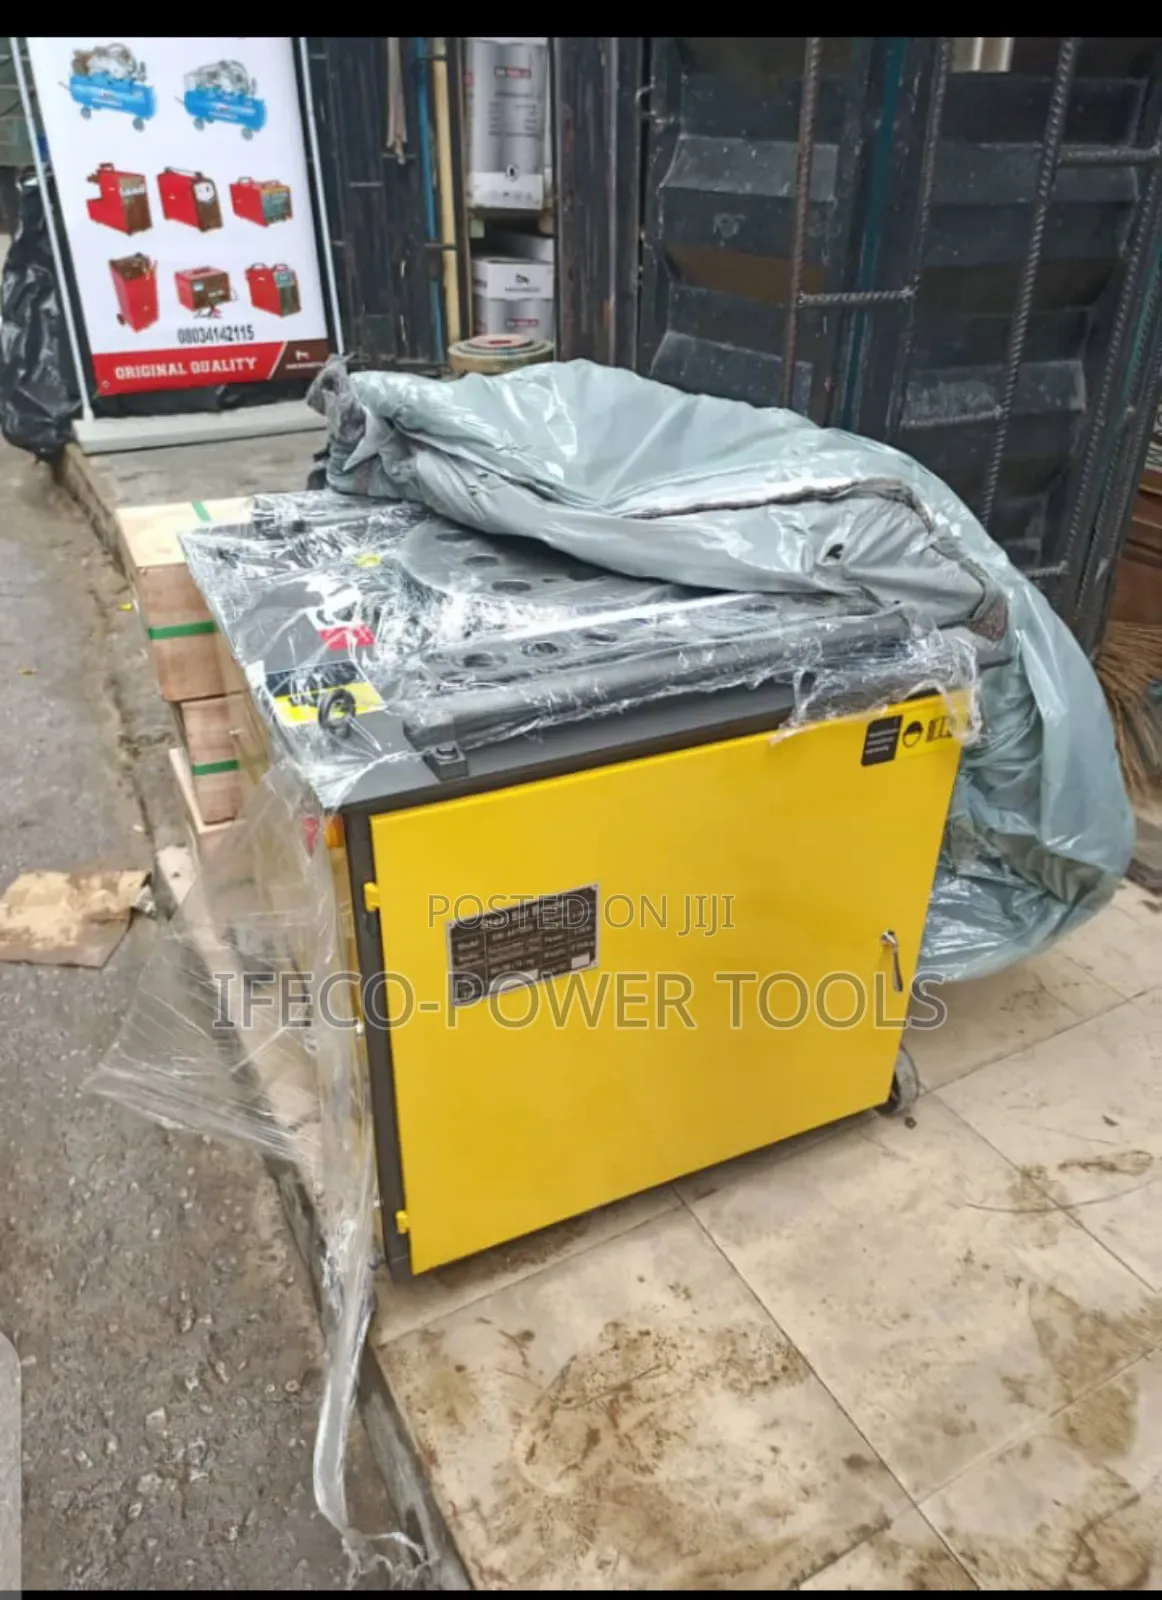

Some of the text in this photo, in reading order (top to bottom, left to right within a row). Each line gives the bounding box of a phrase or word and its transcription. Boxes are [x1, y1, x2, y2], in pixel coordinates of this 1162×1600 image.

[177, 324, 255, 343] 08034142115
[115, 356, 257, 380] ORIGINAL QUALITY
